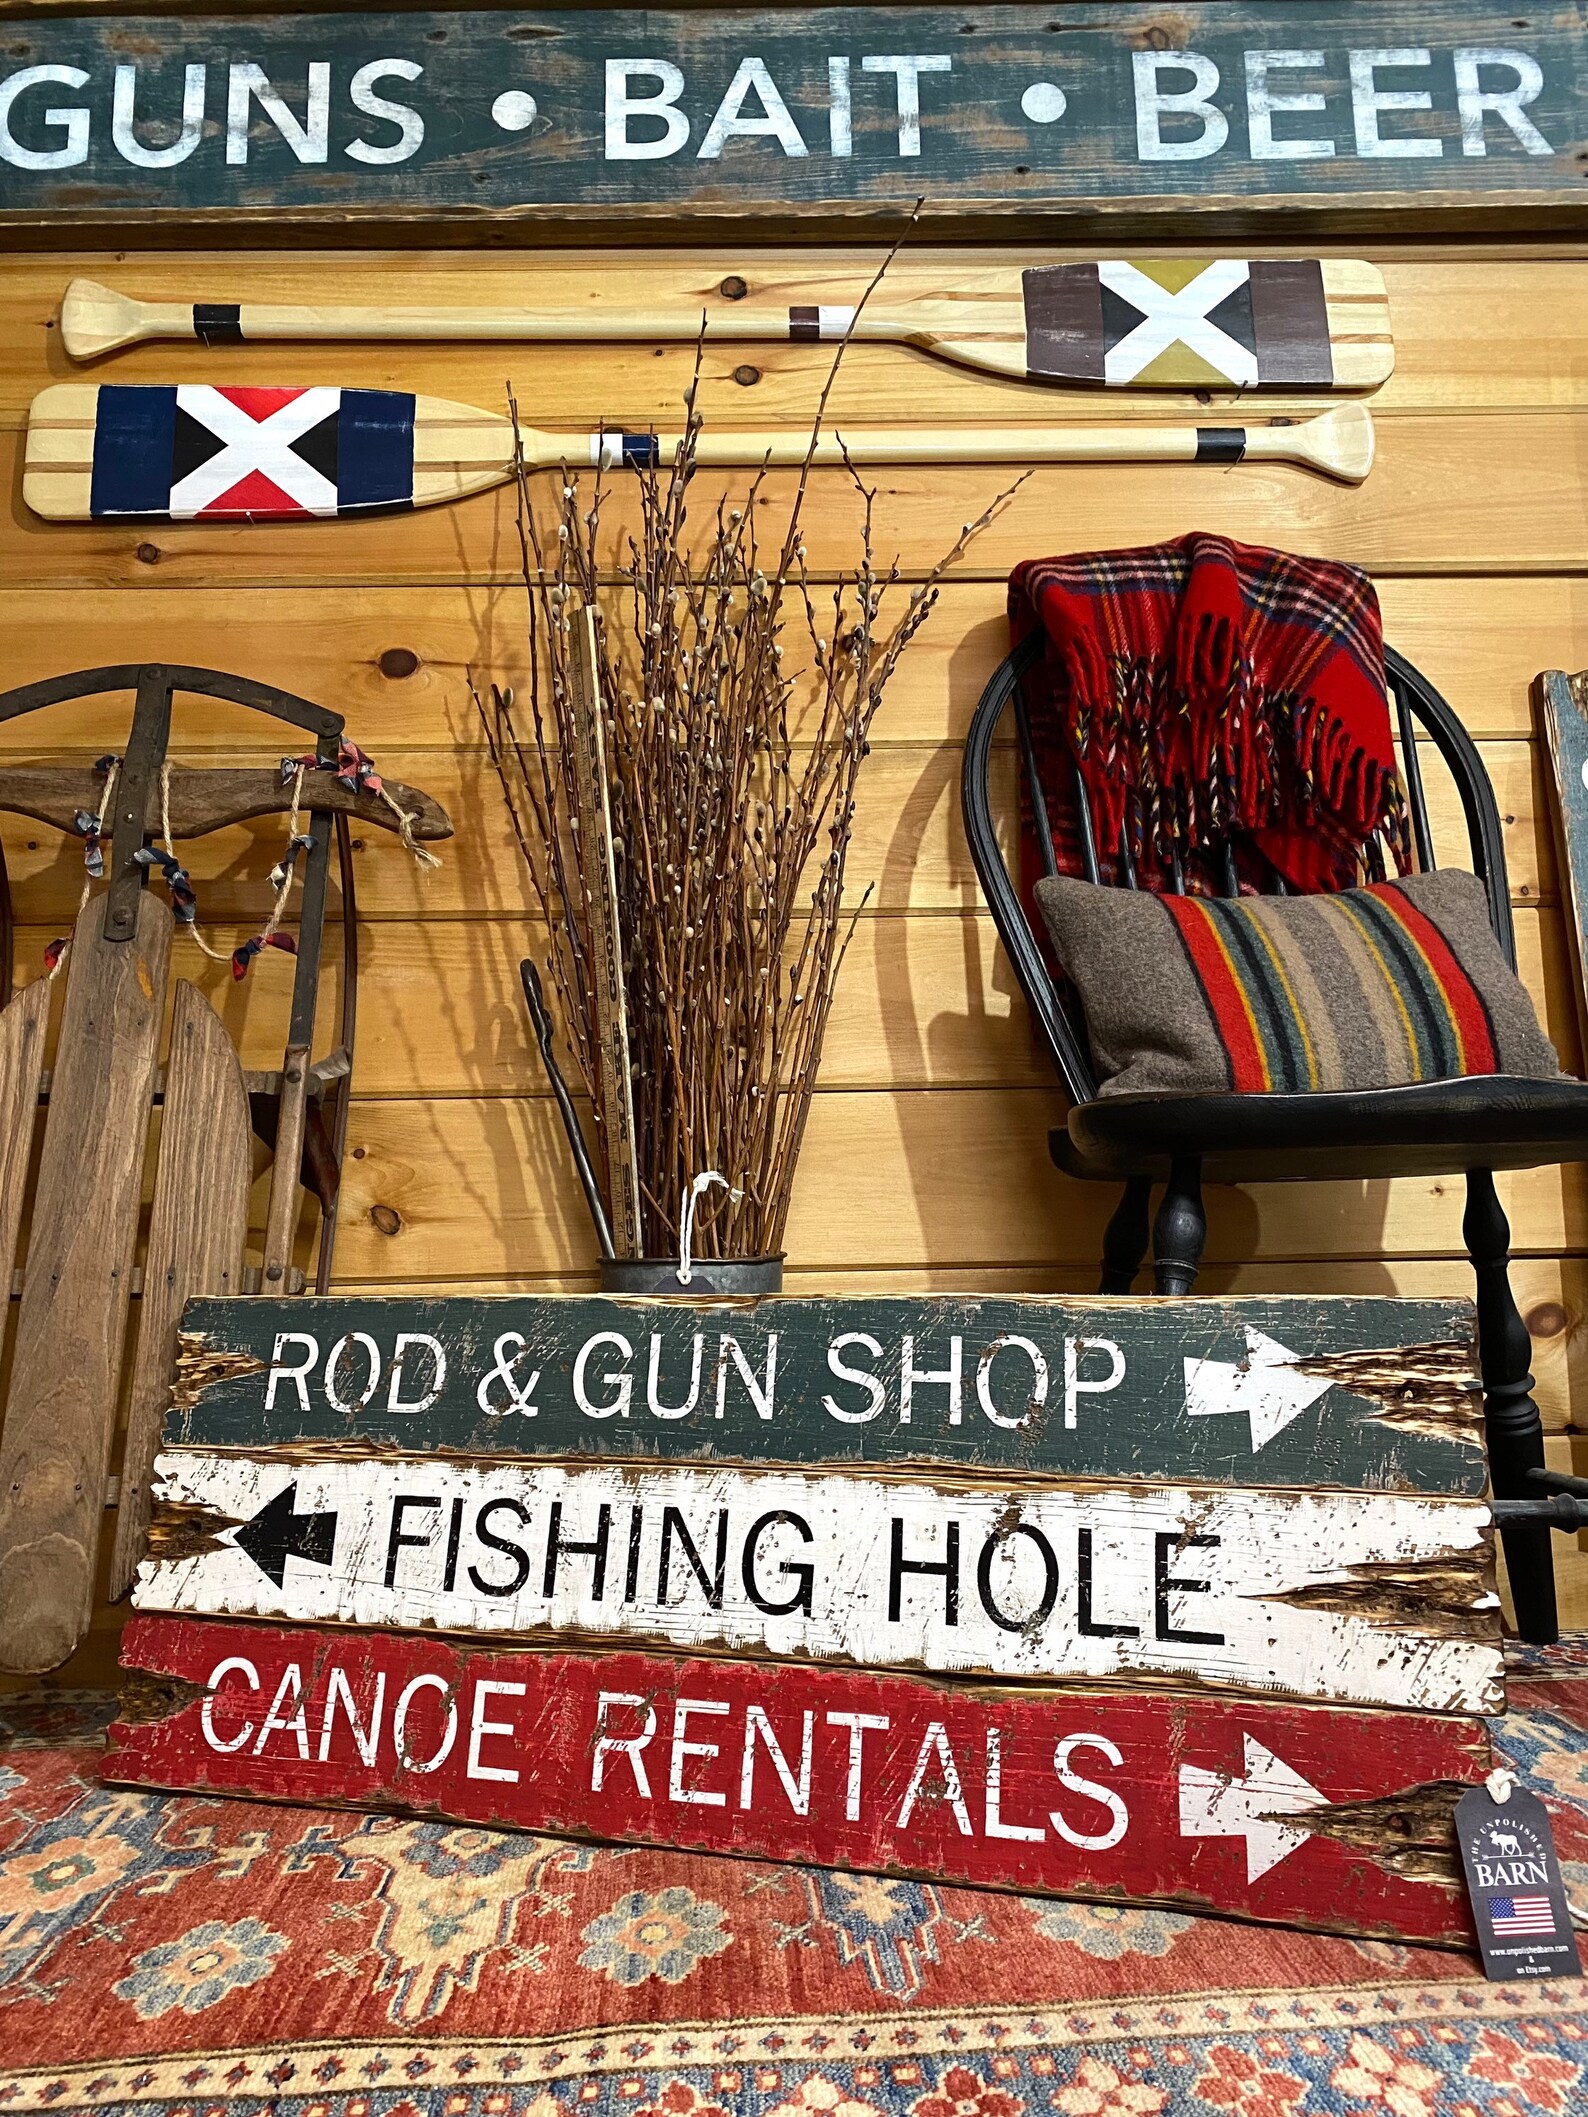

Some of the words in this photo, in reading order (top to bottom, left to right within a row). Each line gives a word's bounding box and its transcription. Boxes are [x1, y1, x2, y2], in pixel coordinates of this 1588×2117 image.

[0, 59, 425, 170] GUNS
[604, 55, 951, 160] BAIT
[1132, 48, 1555, 161] BEER
[598, 832, 617, 1002] COOKING
[613, 1022, 627, 1143] MAKE
[263, 1332, 446, 1414] ROD
[476, 1332, 539, 1417] &
[572, 1332, 778, 1420] GUN
[821, 1333, 1126, 1429] SHOP
[383, 1495, 815, 1617] FISHING
[888, 1517, 1225, 1646] HOLE
[201, 1657, 526, 1782] CANOE
[591, 1692, 1129, 1850] RENTALS
[1471, 1838, 1481, 1863] THE
[1480, 1818, 1547, 1860] UNPOLISHED
[1474, 1860, 1549, 1887] BARN
